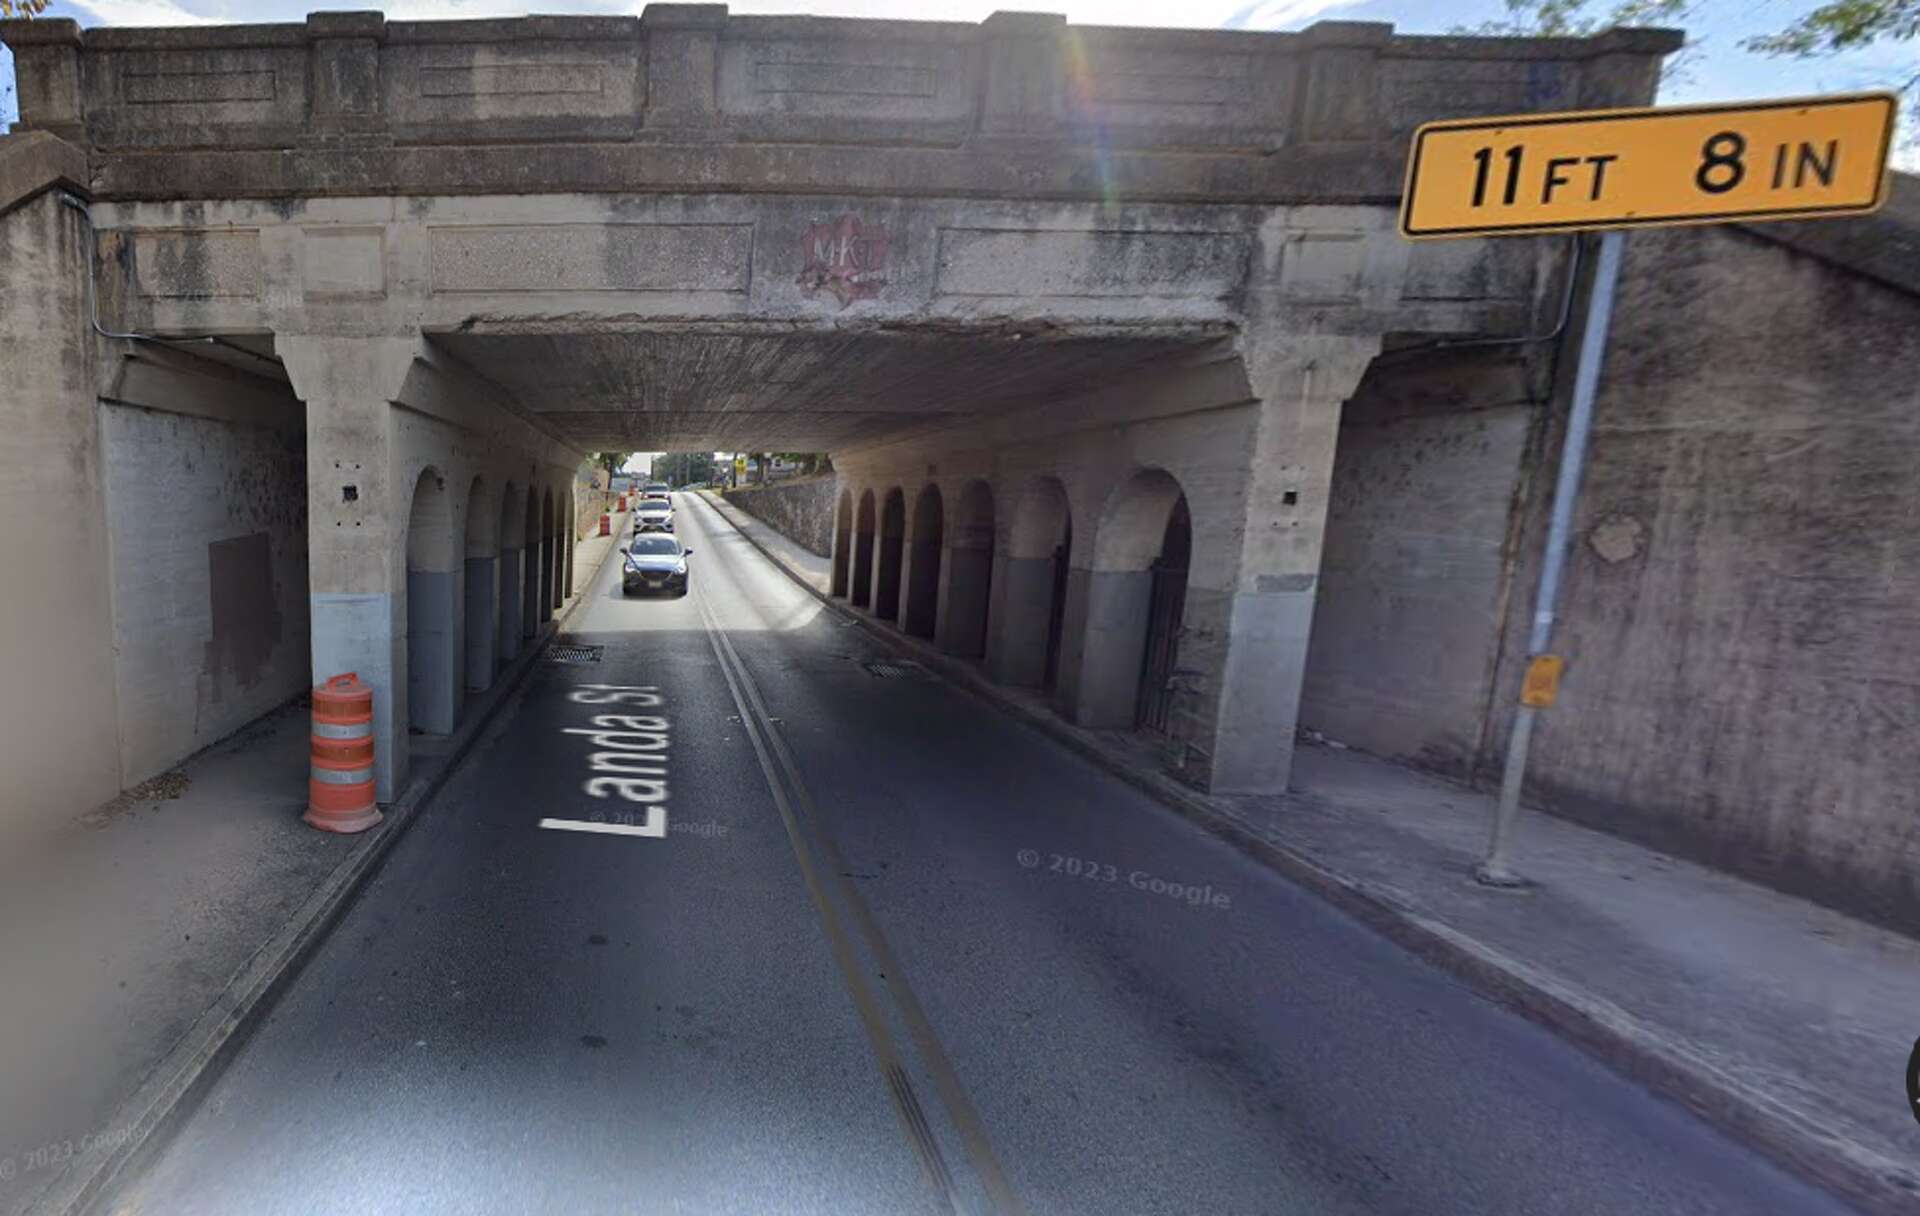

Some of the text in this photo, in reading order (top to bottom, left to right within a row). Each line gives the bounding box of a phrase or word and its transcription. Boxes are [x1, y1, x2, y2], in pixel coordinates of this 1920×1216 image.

[1470, 130, 1839, 208] 11 FT 8 IN
